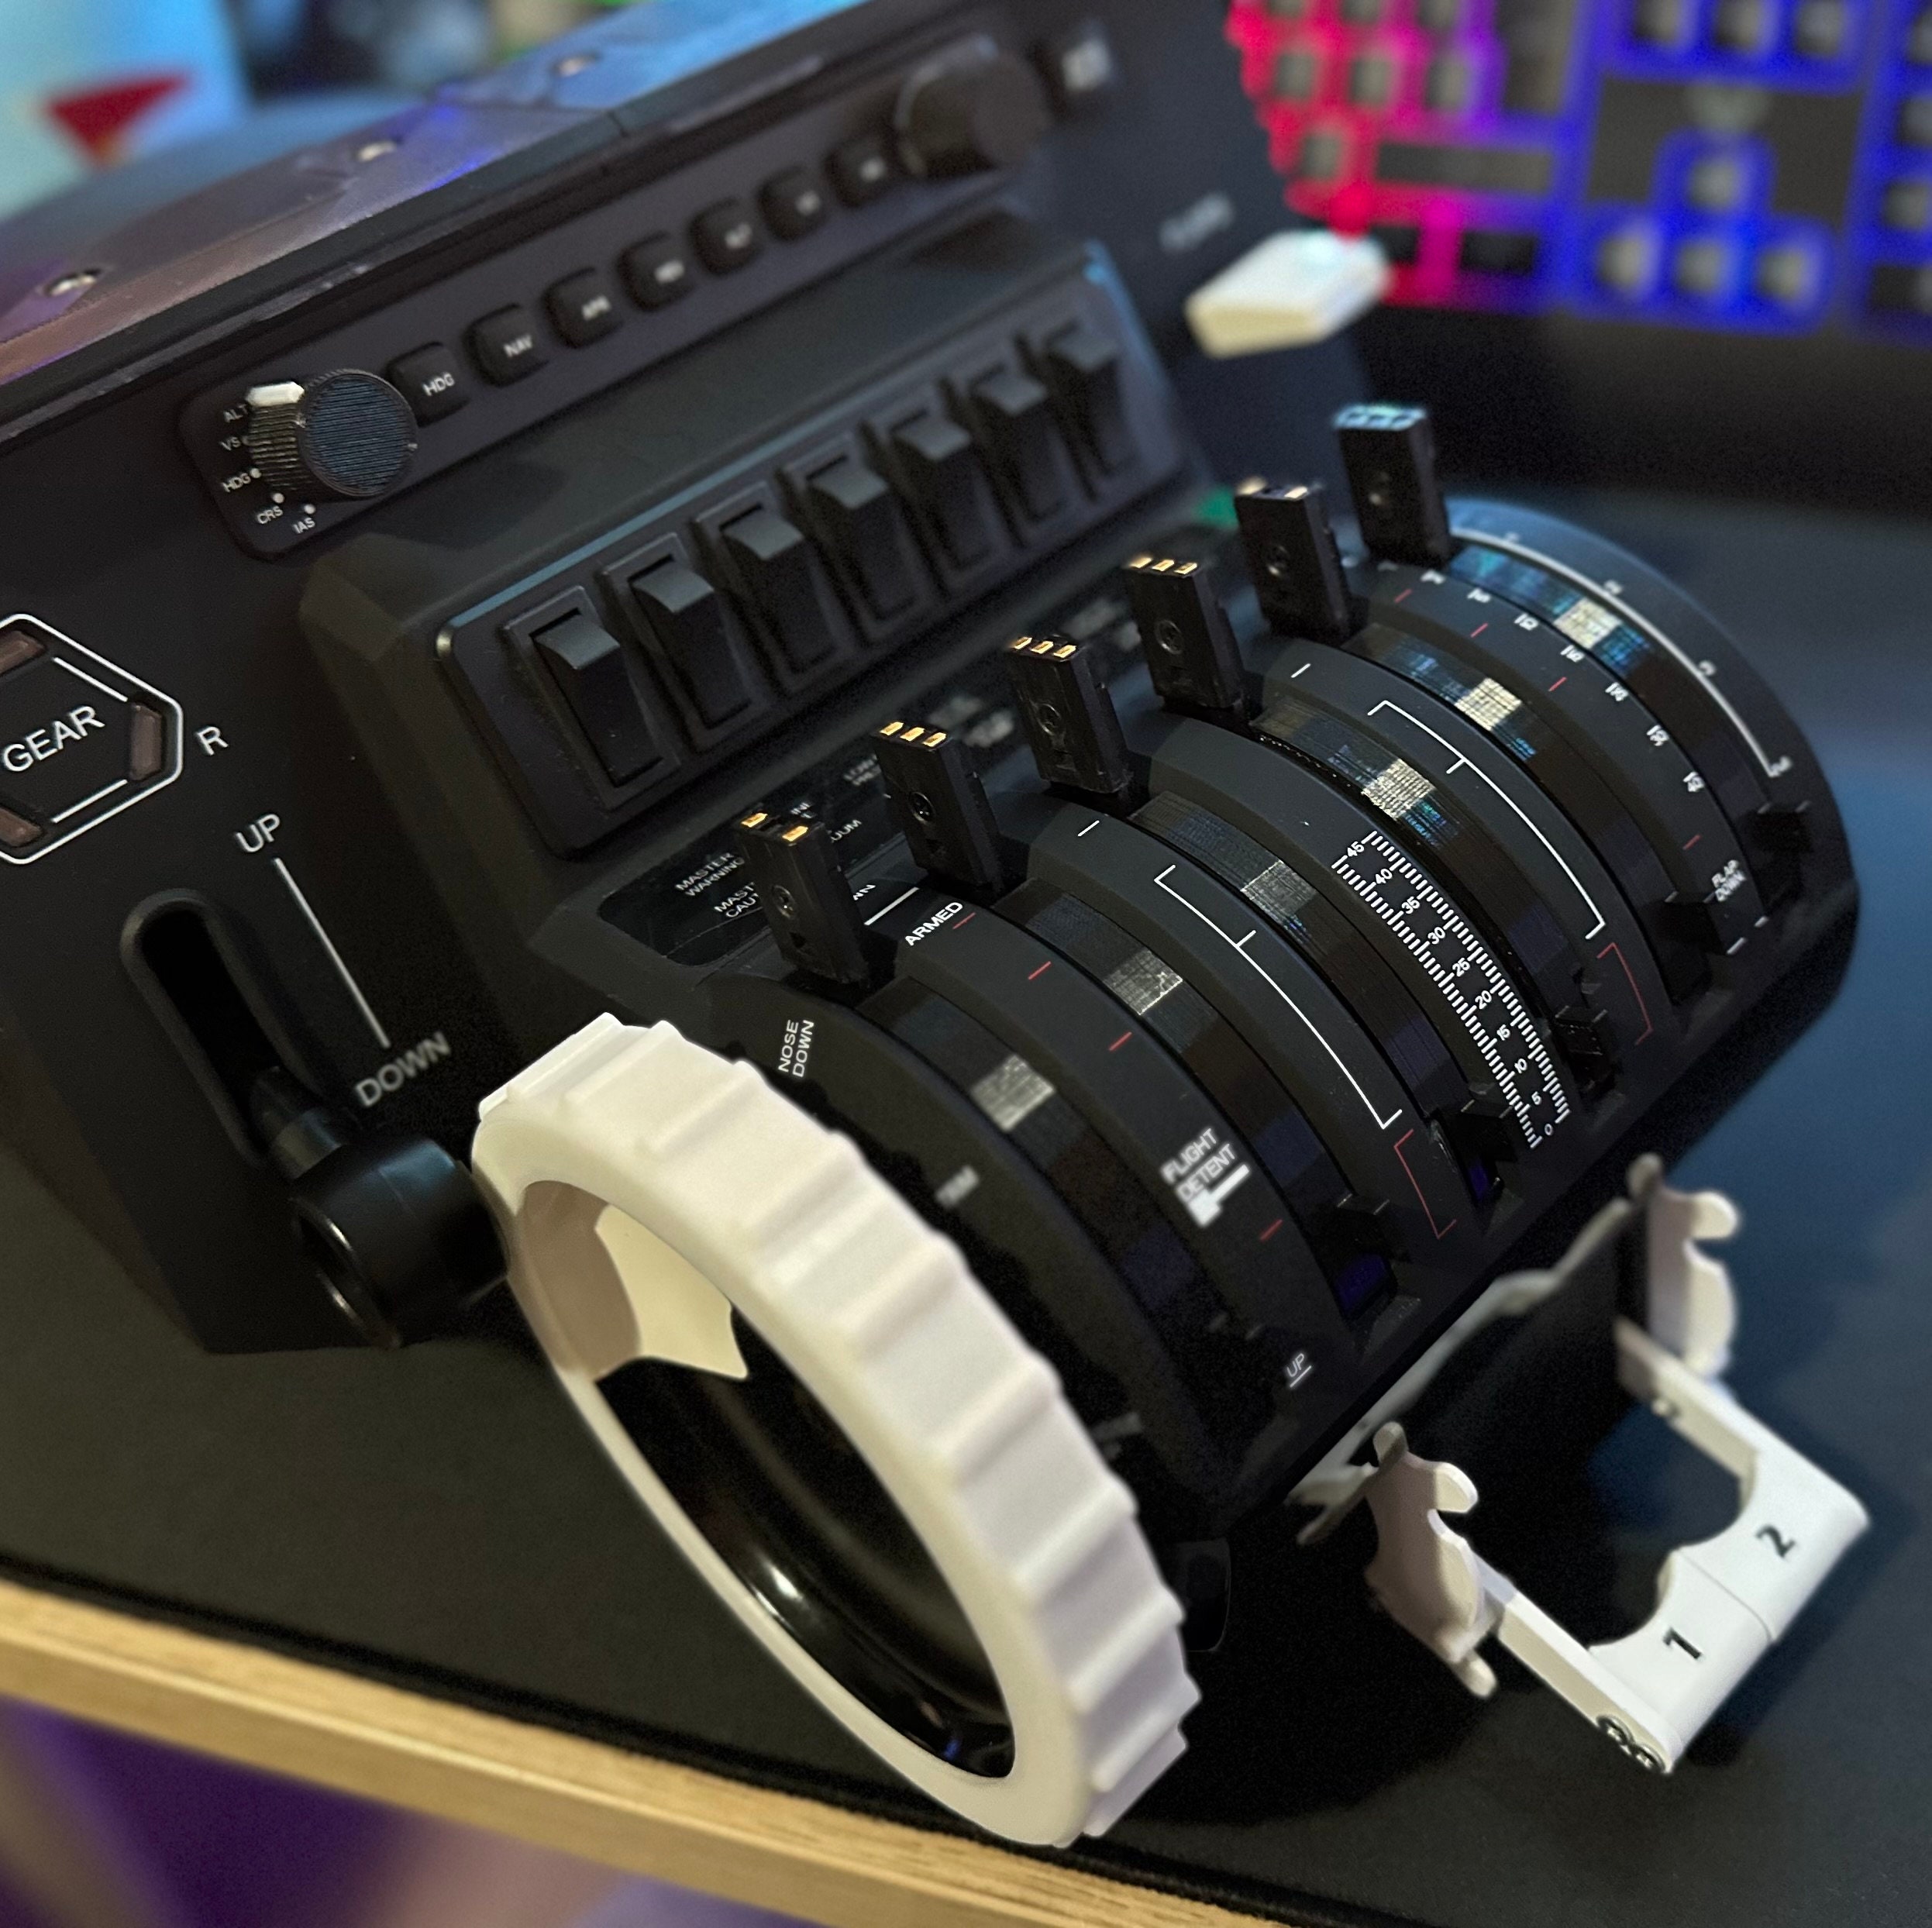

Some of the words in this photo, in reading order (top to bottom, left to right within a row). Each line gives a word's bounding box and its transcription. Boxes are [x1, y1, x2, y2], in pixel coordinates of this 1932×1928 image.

[421, 372, 456, 397] HDG
[220, 436, 241, 451] VS
[221, 471, 252, 493] HDG
[255, 504, 284, 525] CRS
[291, 517, 316, 535] IAS
[2, 704, 106, 773] GEAR
[195, 725, 229, 756] R
[235, 812, 282, 853] UP
[1347, 841, 1365, 857] 45
[675, 852, 734, 890] MASTER
[685, 856, 745, 896] WARNING
[1375, 868, 1393, 884] 40
[714, 882, 755, 912] MAST
[1401, 896, 1421, 914] 35
[905, 901, 964, 946] ARMED
[1427, 926, 1446, 945] 30
[1452, 957, 1470, 977] 25
[1474, 990, 1493, 1010] 20
[1496, 1024, 1511, 1041] 15
[777, 1019, 799, 1073] NOSE
[792, 1019, 815, 1078] DOWN
[354, 1031, 453, 1107] DOWN
[1514, 1058, 1528, 1074] 10
[1531, 1090, 1542, 1106] 5
[1544, 1123, 1554, 1136] 0
[1162, 1128, 1217, 1184] FLIGHT
[1176, 1143, 1235, 1202] DETENT
[1286, 1352, 1305, 1378] UP
[1755, 1524, 1797, 1559] 2
[1662, 1627, 1703, 1660] 1
